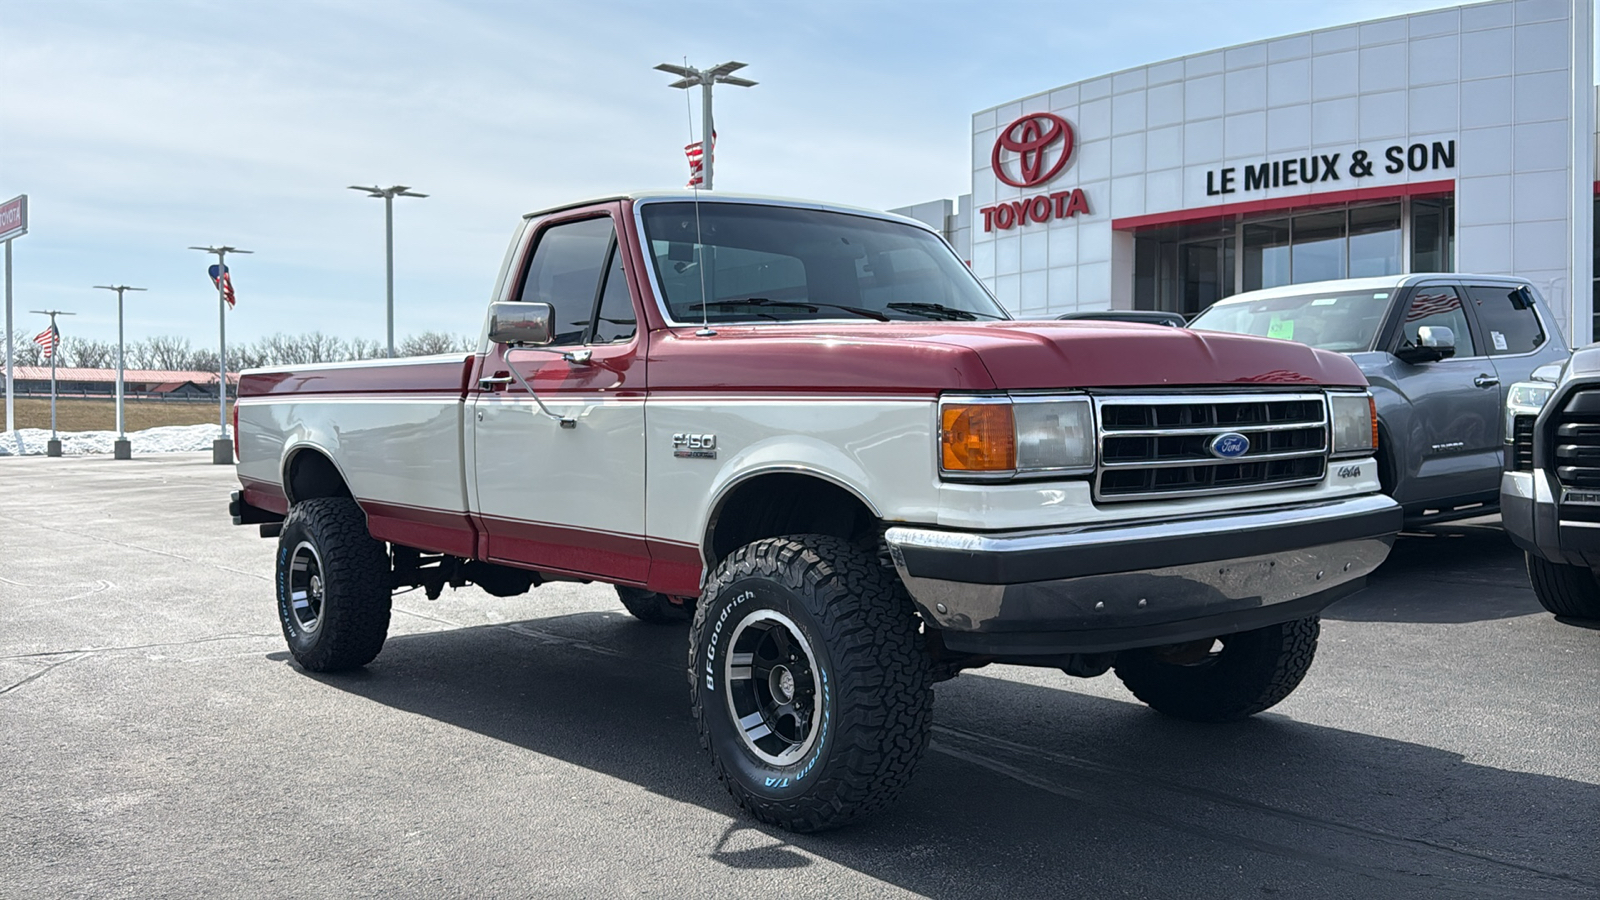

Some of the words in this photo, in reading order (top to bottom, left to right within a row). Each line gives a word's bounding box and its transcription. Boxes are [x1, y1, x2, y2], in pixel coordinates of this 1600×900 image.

[1206, 167, 1236, 196] LE
[1243, 152, 1340, 191] MIEUX
[1348, 150, 1374, 178] &
[1384, 140, 1455, 174] SON
[979, 188, 1090, 233] TOYOTA
[1221, 438, 1242, 453] Ford
[706, 590, 755, 691] BFGoodrich
[764, 776, 790, 788] T/A
